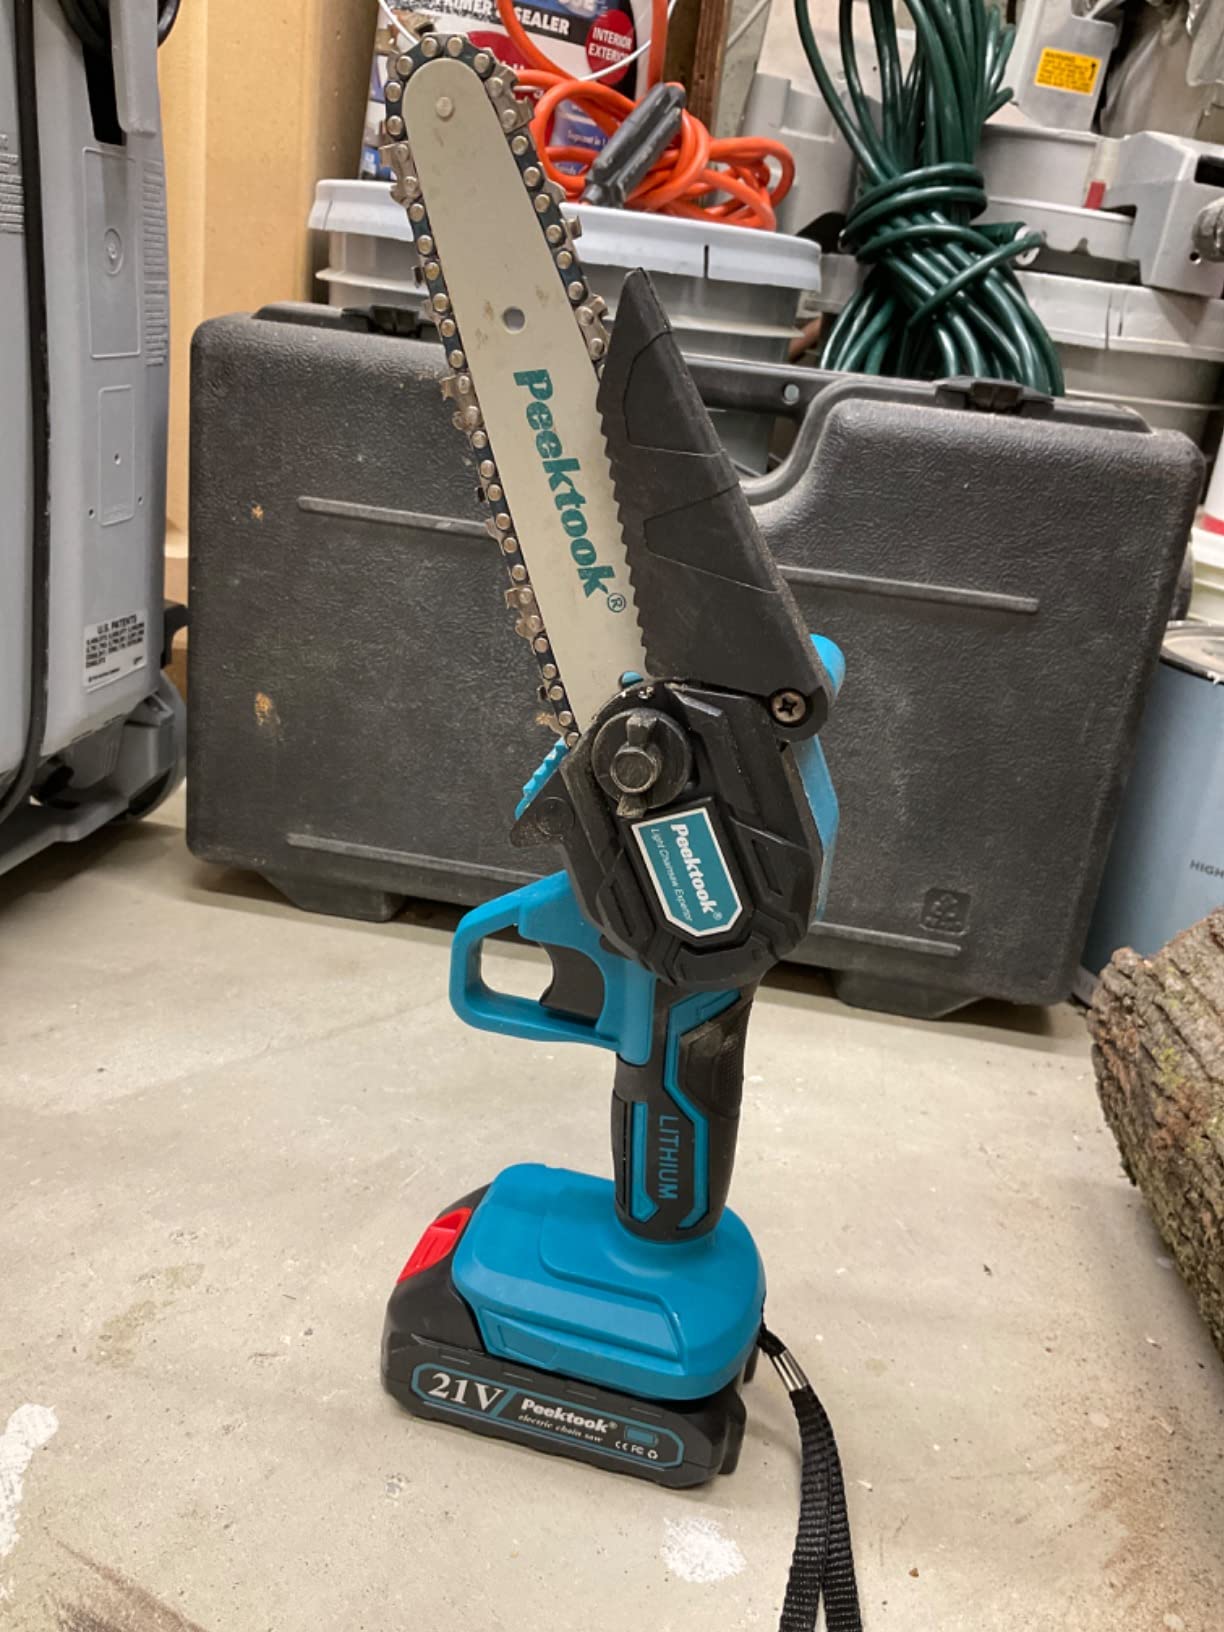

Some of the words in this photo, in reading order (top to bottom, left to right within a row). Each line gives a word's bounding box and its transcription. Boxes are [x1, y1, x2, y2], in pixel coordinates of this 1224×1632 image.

[592, 26, 632, 50] INTERIOR
[658, 1115, 680, 1199] LITHIUM
[428, 1372, 504, 1411] 21V
[518, 1414, 553, 1429] electric
[555, 1424, 582, 1438] chain
